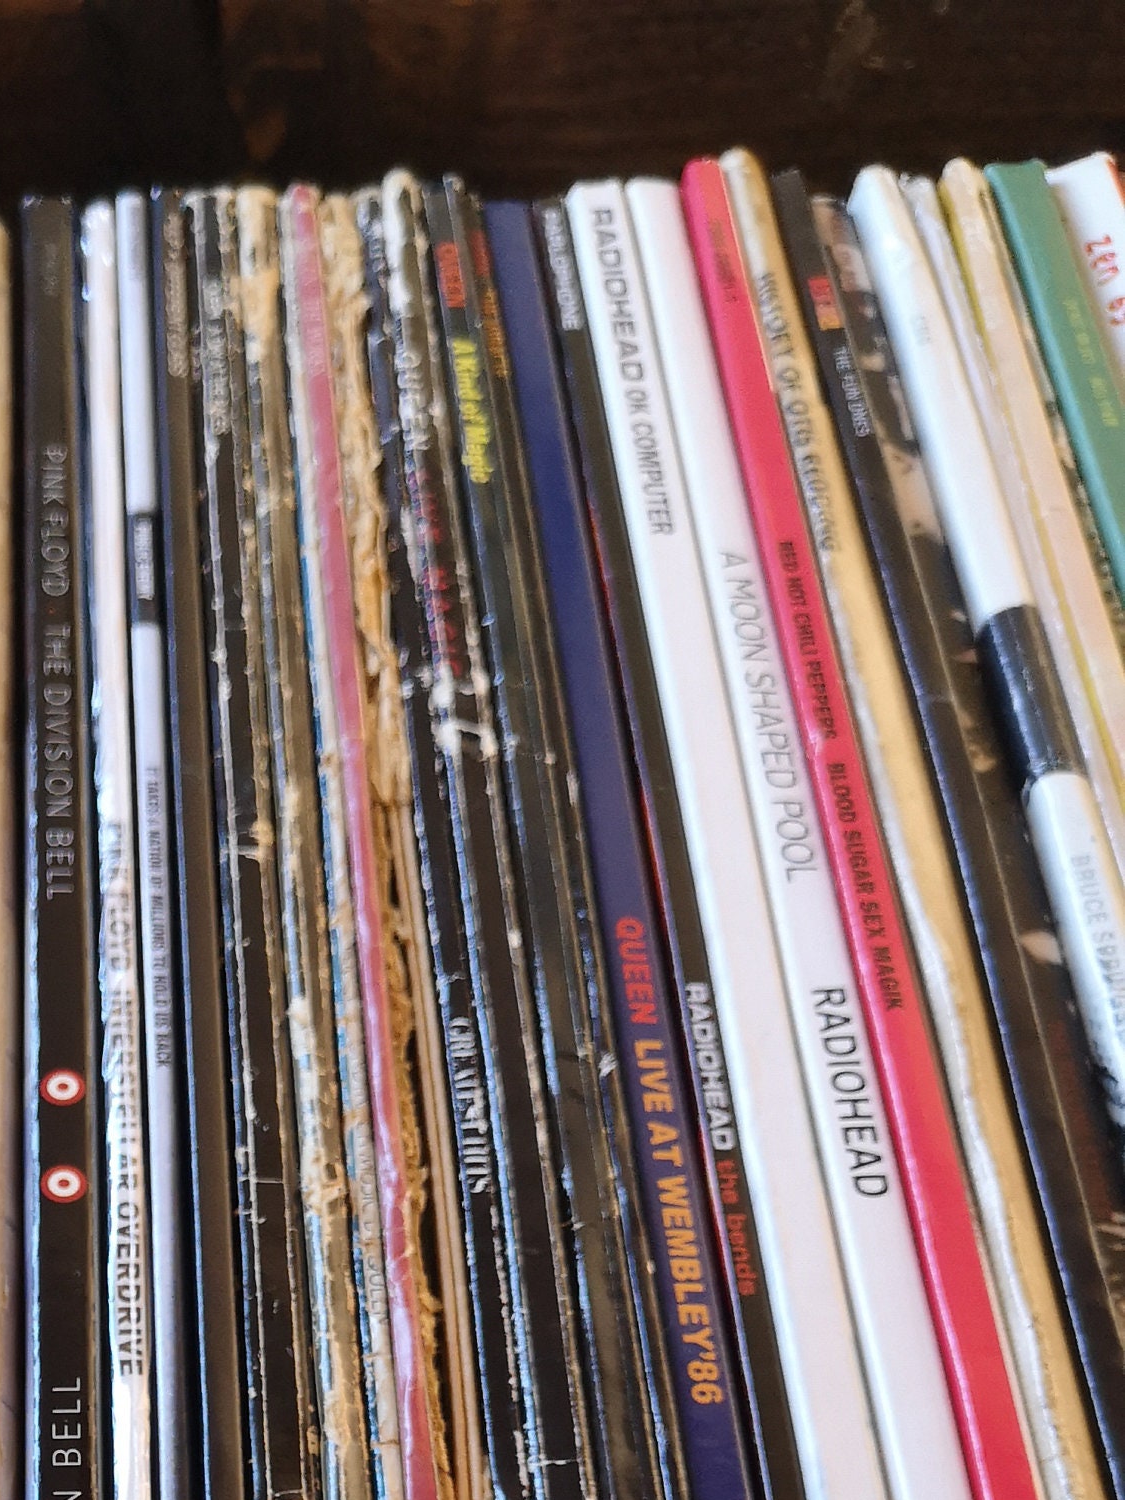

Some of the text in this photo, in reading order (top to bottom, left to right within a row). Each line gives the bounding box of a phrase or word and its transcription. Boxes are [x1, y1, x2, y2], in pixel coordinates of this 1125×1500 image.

[587, 207, 676, 539] RADIOHEAD OK COMPUTER
[38, 443, 75, 900] PINK FLOYD THE DIVISION BELL
[802, 658, 839, 743] PEPPERS
[717, 546, 818, 885] A MOON SHAPED POOL
[825, 758, 858, 825] BLOOD
[148, 829, 163, 872] NATION
[840, 825, 876, 899] SUGAR
[149, 895, 166, 952] MILLIONS
[858, 898, 886, 940] SEX
[153, 975, 168, 1009] HOLD
[613, 915, 658, 1027] QUEEN
[870, 942, 905, 1014] MAGIK
[154, 1011, 168, 1029] US
[155, 1032, 170, 1069] BACK
[632, 1035, 674, 1117] LIVE
[808, 981, 891, 1205] RADIOHEAD
[646, 1117, 684, 1172] AT
[684, 978, 759, 1298] RADIOHEAD the bends
[111, 1197, 146, 1377] OVERDRIVE
[51, 1377, 82, 1465] BELL
